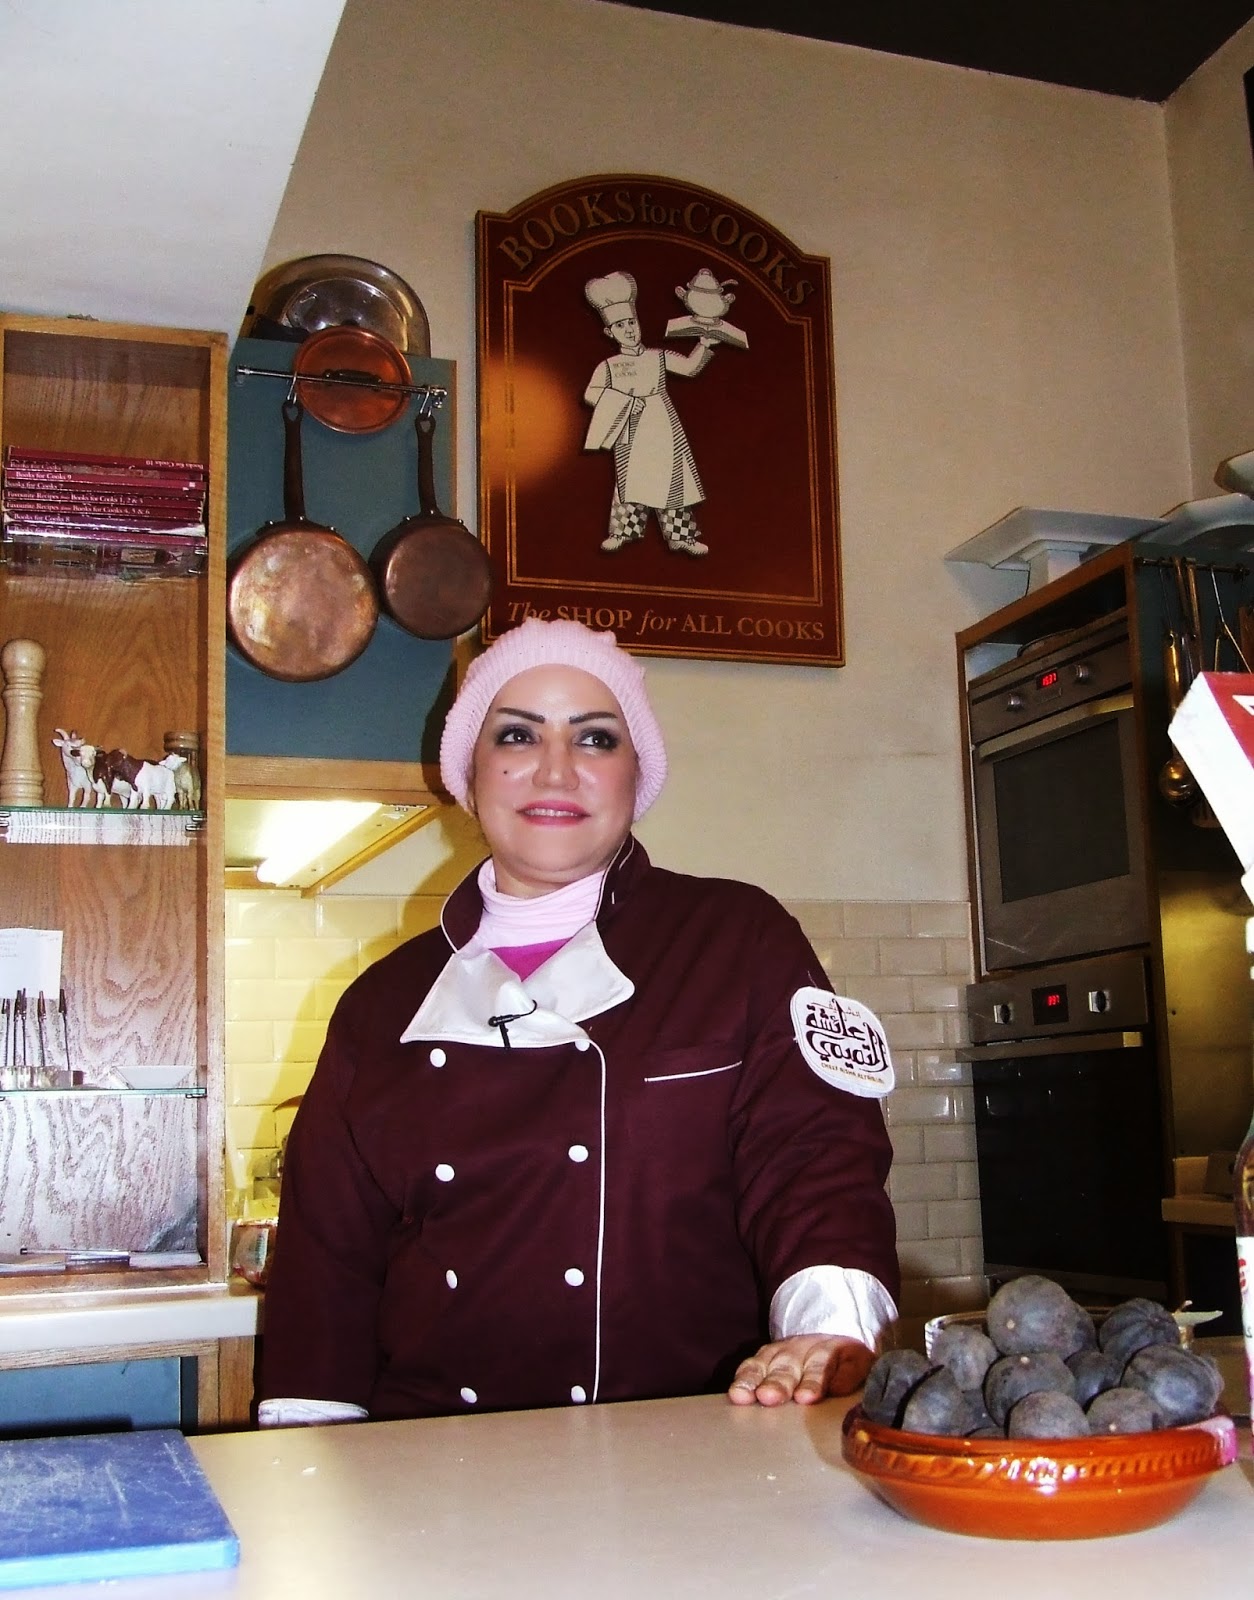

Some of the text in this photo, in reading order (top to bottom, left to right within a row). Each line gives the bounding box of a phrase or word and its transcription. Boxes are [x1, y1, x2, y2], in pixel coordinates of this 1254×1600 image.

[497, 190, 814, 304] BOOKS for COOKS
[46, 472, 66, 480] Cooks
[71, 493, 90, 501] Books
[100, 495, 118, 503] Cooks
[36, 503, 59, 511] Recipes
[73, 504, 92, 512] Books
[508, 601, 825, 641] The SHOP for ALL COOKS
